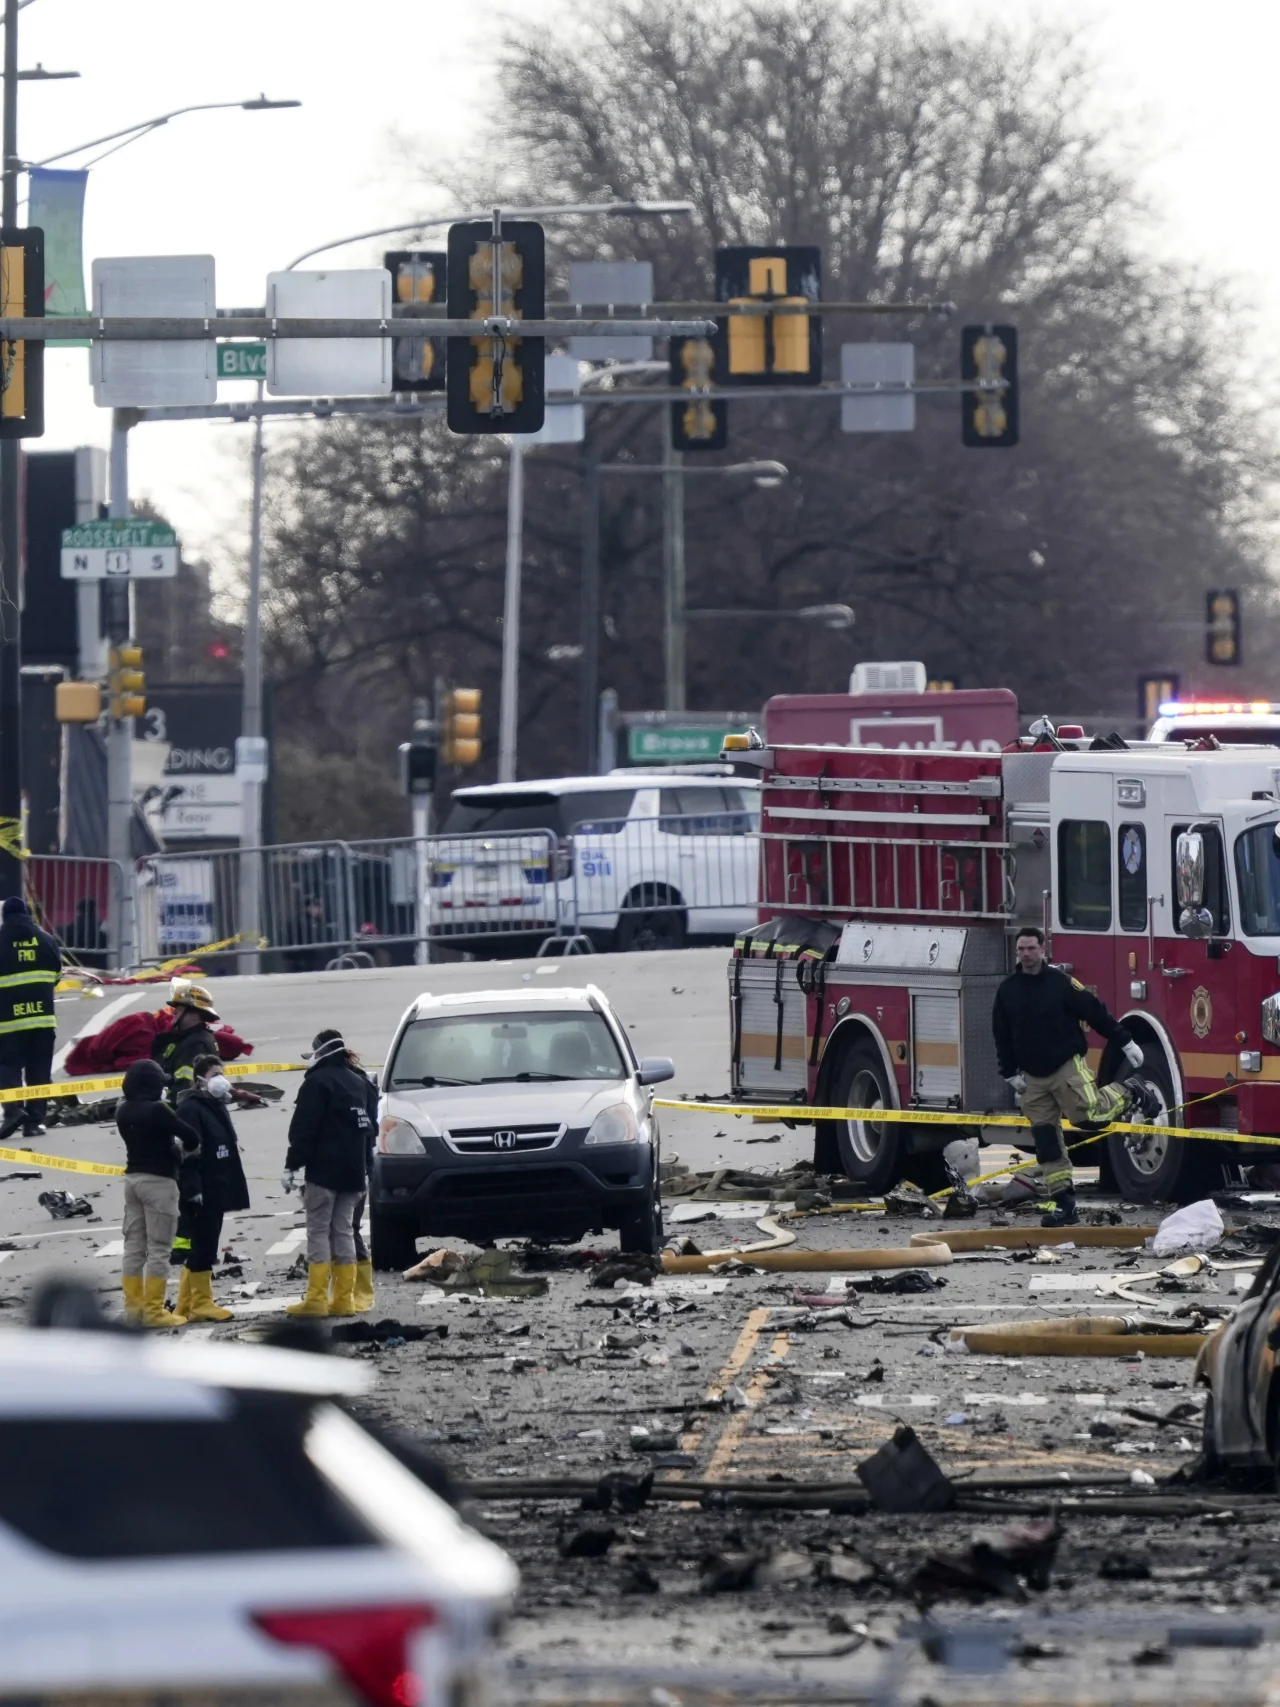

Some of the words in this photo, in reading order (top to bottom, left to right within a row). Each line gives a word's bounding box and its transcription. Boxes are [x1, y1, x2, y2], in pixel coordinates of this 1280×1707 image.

[62, 529, 148, 547] ROOSEVELT
[74, 555, 88, 570] N
[152, 555, 164, 570] S
[582, 861, 612, 878] 911
[13, 1001, 44, 1016] BEALE
